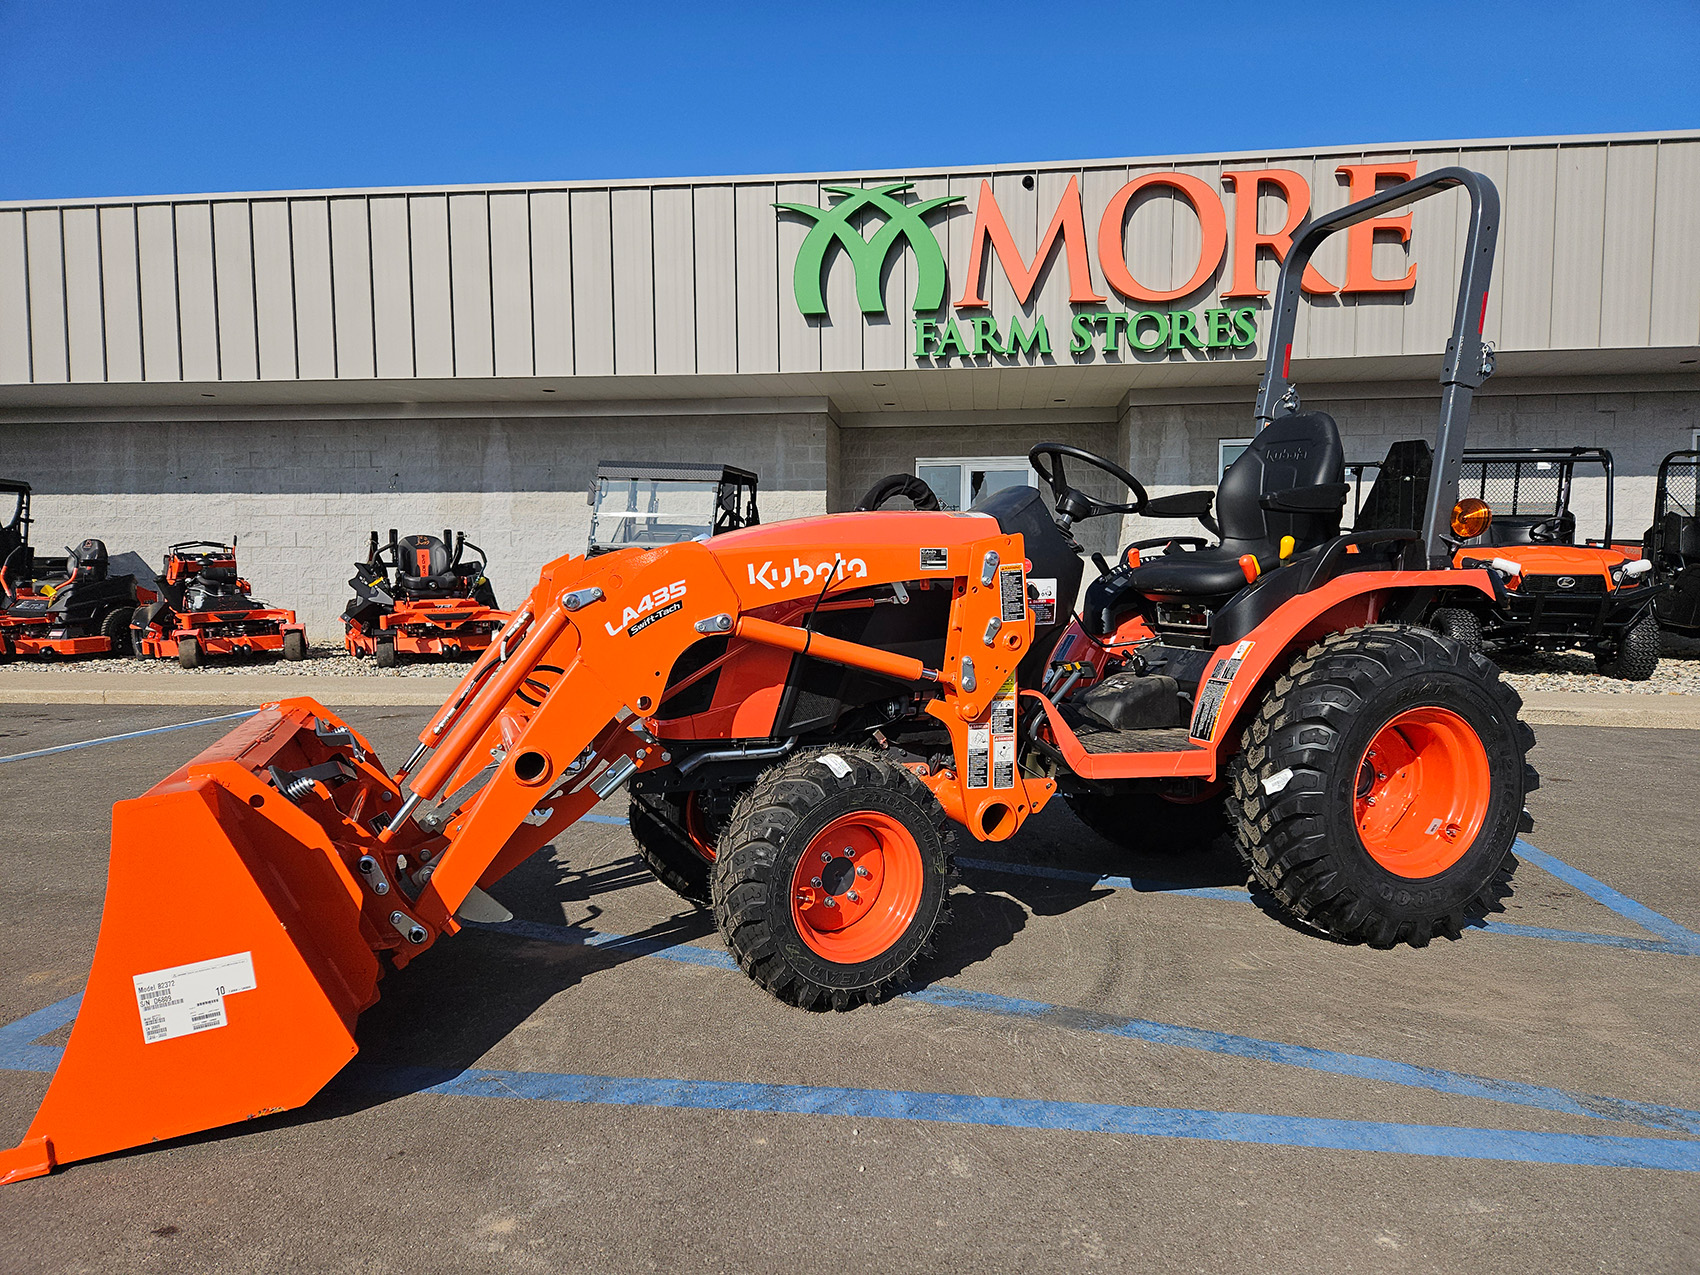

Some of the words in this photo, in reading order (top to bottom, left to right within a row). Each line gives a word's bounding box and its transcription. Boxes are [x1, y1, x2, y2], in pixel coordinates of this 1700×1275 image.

[954, 160, 1417, 307] MORE
[913, 315, 1052, 358] FARM
[1070, 307, 1258, 355] STORES
[747, 553, 868, 590] Kubota
[604, 579, 687, 636] LA435
[630, 603, 681, 635] Swift-Tach
[808, 923, 927, 986] GOODYEAR
[138, 984, 156, 993] Model
[215, 985, 226, 996] 10
